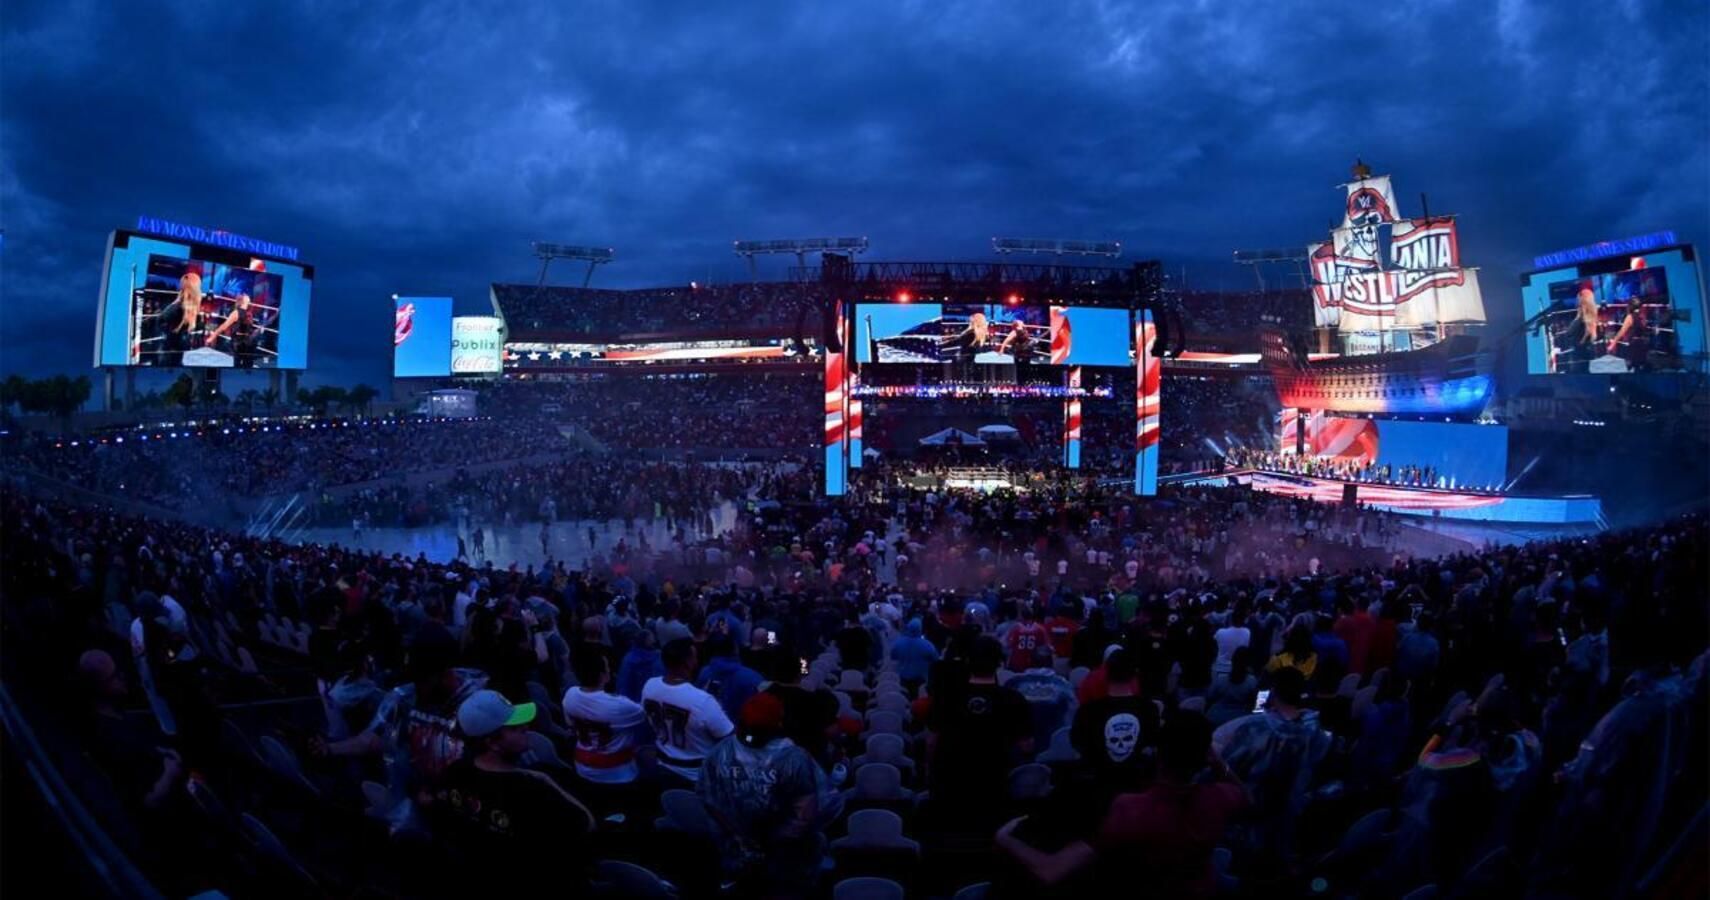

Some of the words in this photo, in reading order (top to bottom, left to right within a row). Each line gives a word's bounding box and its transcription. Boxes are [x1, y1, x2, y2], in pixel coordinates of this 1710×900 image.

[138, 214, 205, 242] RAYMOND
[206, 230, 246, 249] JAMES
[248, 239, 298, 261] STADIUM
[451, 339, 496, 350] Publix
